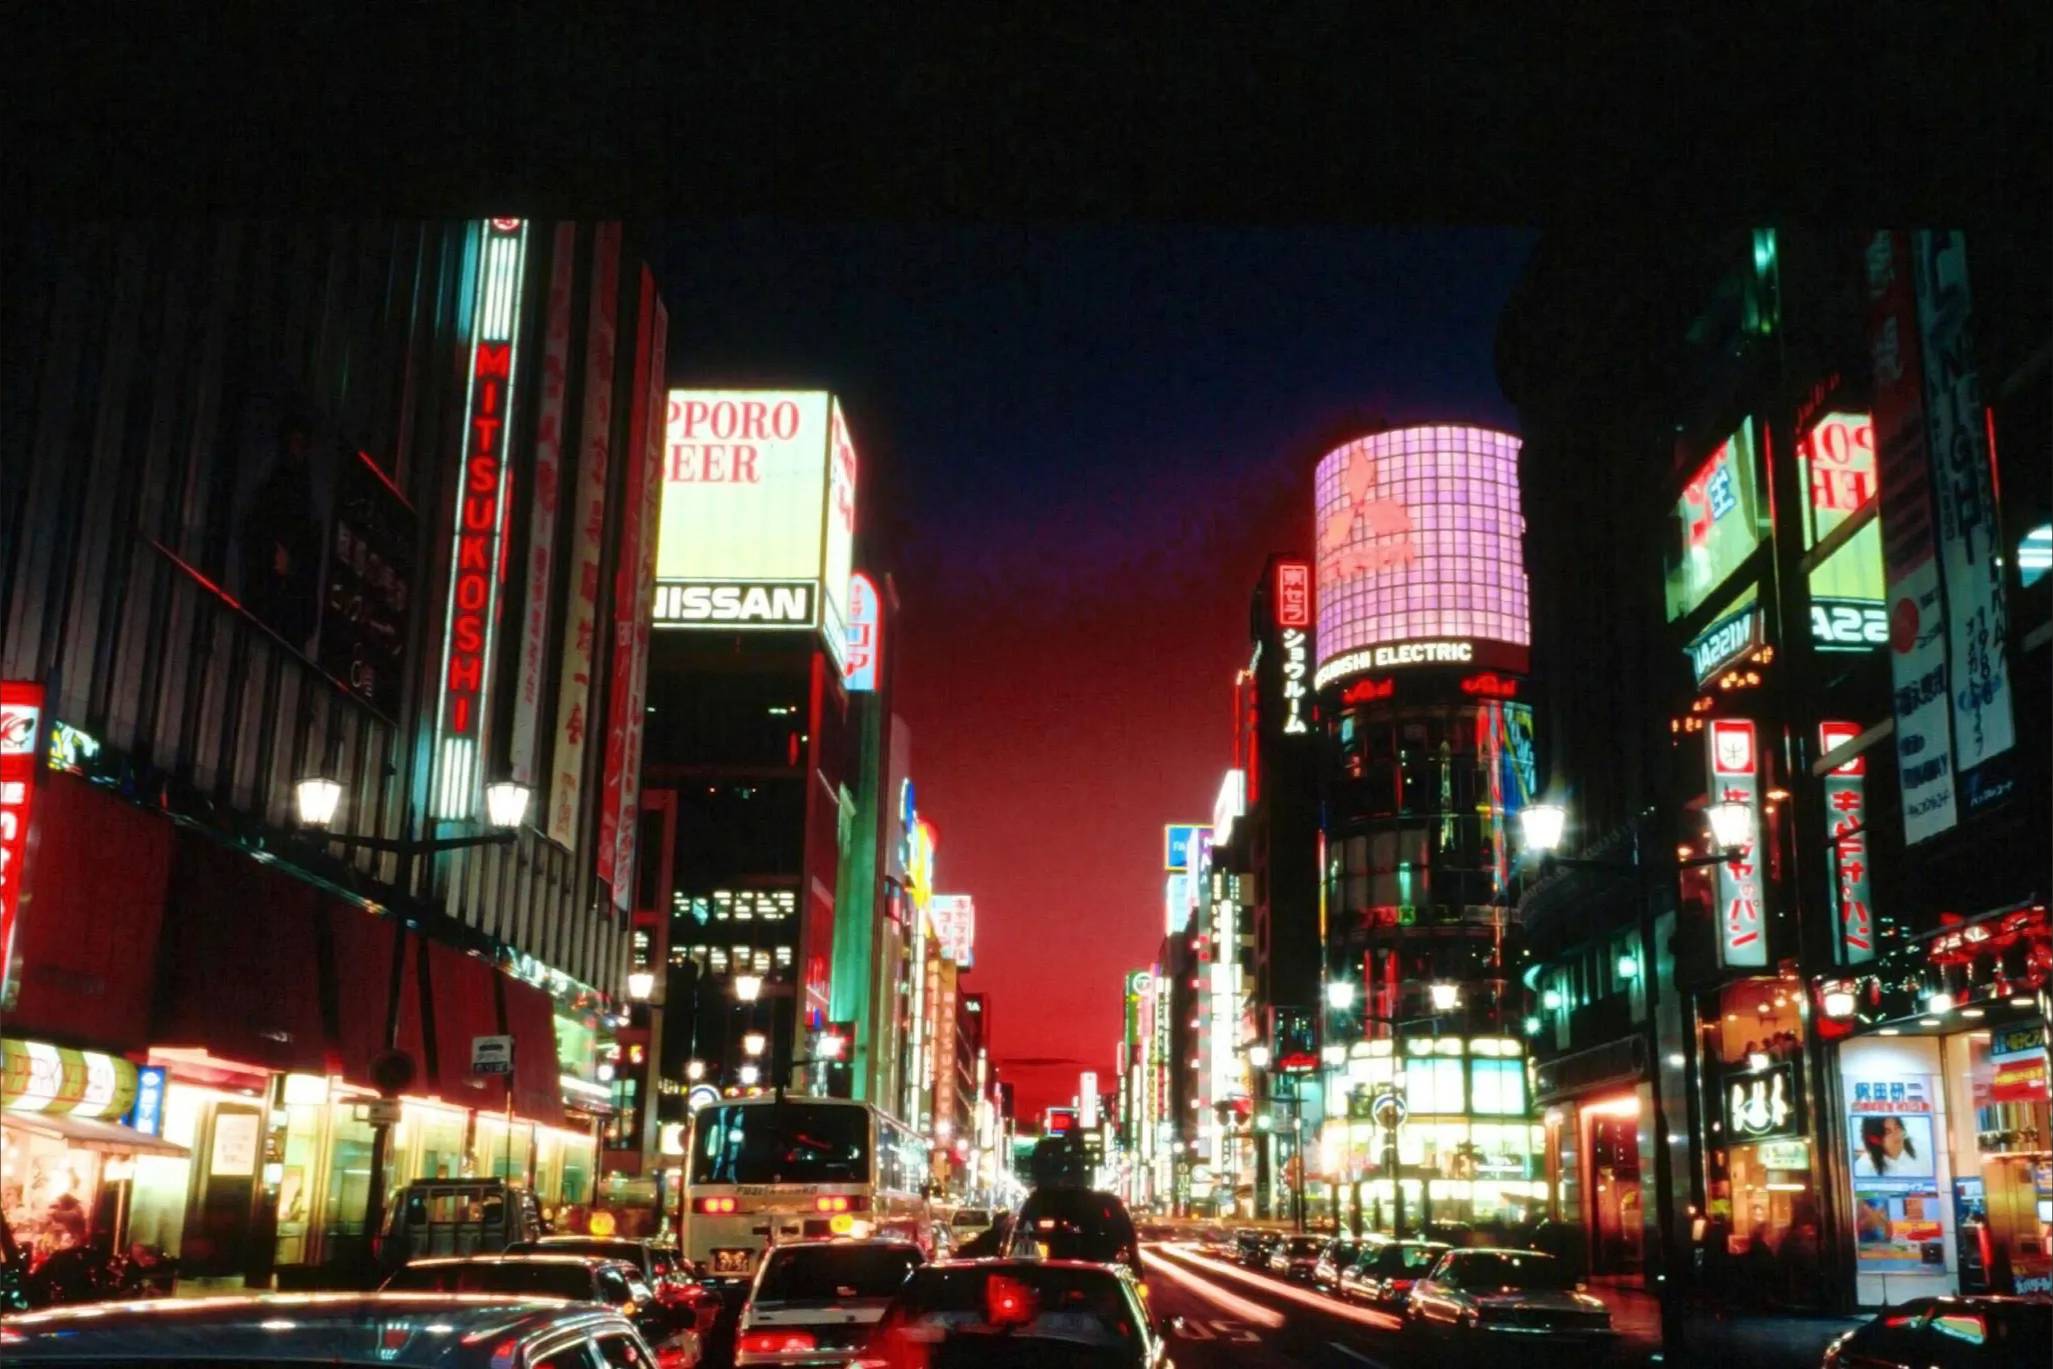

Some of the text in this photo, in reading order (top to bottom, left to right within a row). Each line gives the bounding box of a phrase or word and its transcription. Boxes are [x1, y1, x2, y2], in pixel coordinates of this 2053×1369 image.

[664, 443, 760, 483] EER
[447, 343, 511, 734] MITSUKOSHI
[1282, 568, 1305, 621] 京セラ
[1282, 627, 1306, 733] ショウルーム
[1376, 643, 1472, 665] ELECTRIC
[1722, 788, 1760, 947] キヤのパン
